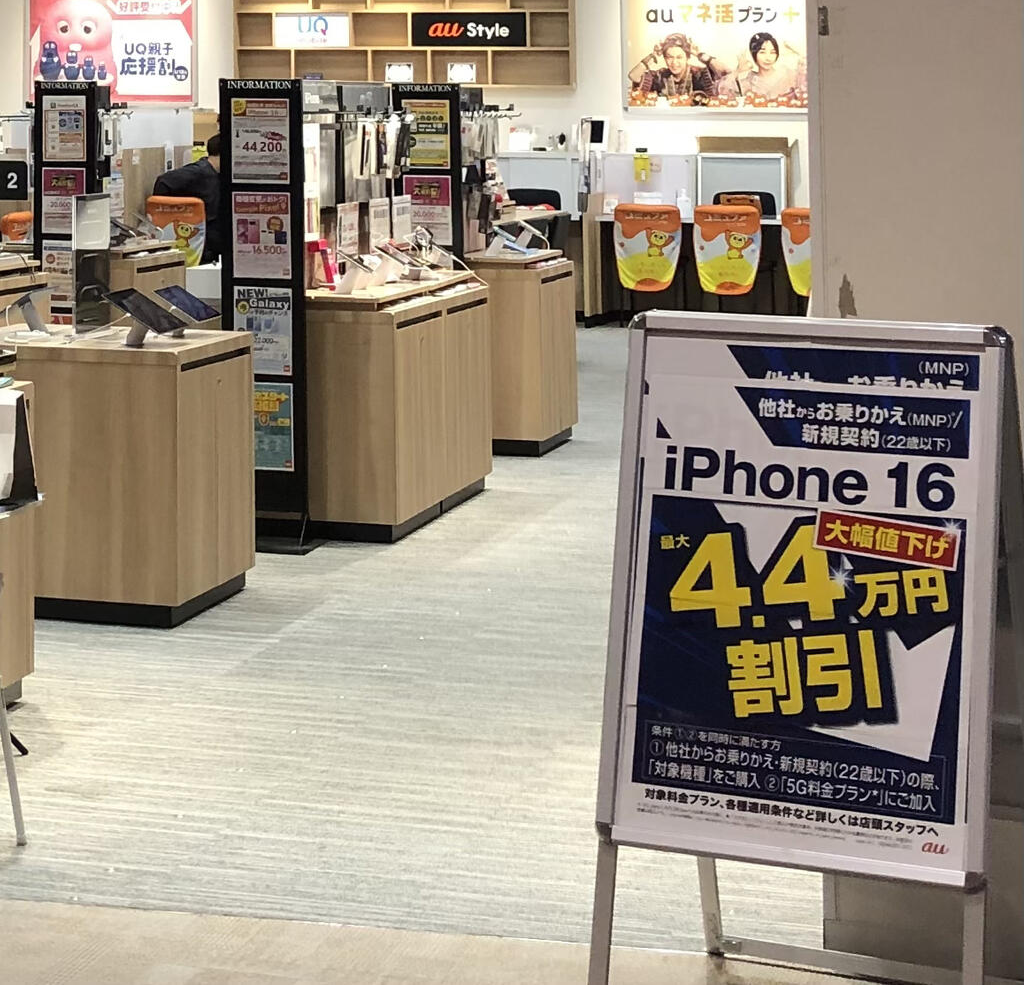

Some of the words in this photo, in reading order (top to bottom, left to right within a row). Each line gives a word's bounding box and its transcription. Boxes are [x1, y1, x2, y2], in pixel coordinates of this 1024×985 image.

[298, 16, 328, 36] UQ
[428, 22, 464, 38] au
[466, 23, 509, 39] Style
[227, 80, 292, 90] INFORMATION
[7, 172, 18, 189] 2
[237, 288, 268, 298] NEW!
[249, 298, 289, 311] Galaxy
[918, 361, 969, 376] (MNP)
[802, 423, 952, 453] 新規契約(22歳以下)
[664, 445, 868, 506] iPhone
[887, 461, 956, 512] 16
[660, 534, 690, 550] 最大
[825, 519, 950, 560] 大幅値下げ
[669, 524, 950, 629] 4.4万円
[725, 629, 883, 718] 割引
[921, 842, 949, 855] au
